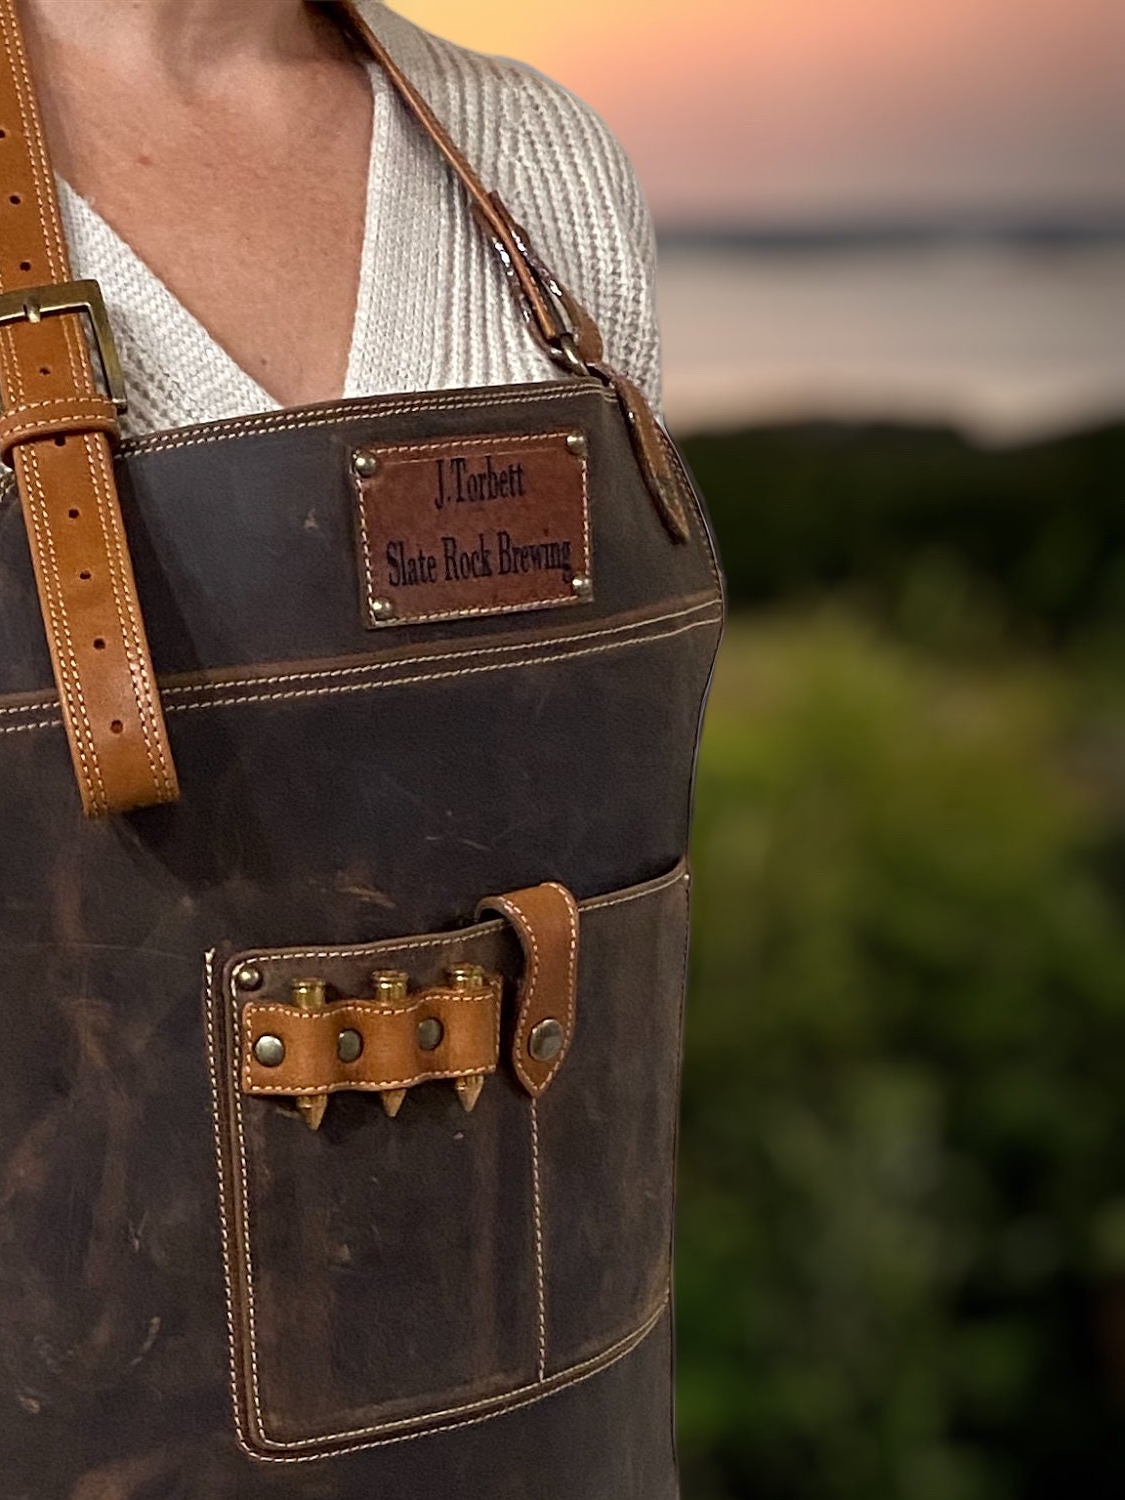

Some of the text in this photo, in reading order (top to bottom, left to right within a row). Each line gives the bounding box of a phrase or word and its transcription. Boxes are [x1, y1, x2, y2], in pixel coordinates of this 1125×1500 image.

[386, 531, 574, 587] Slate Rock Brewing
